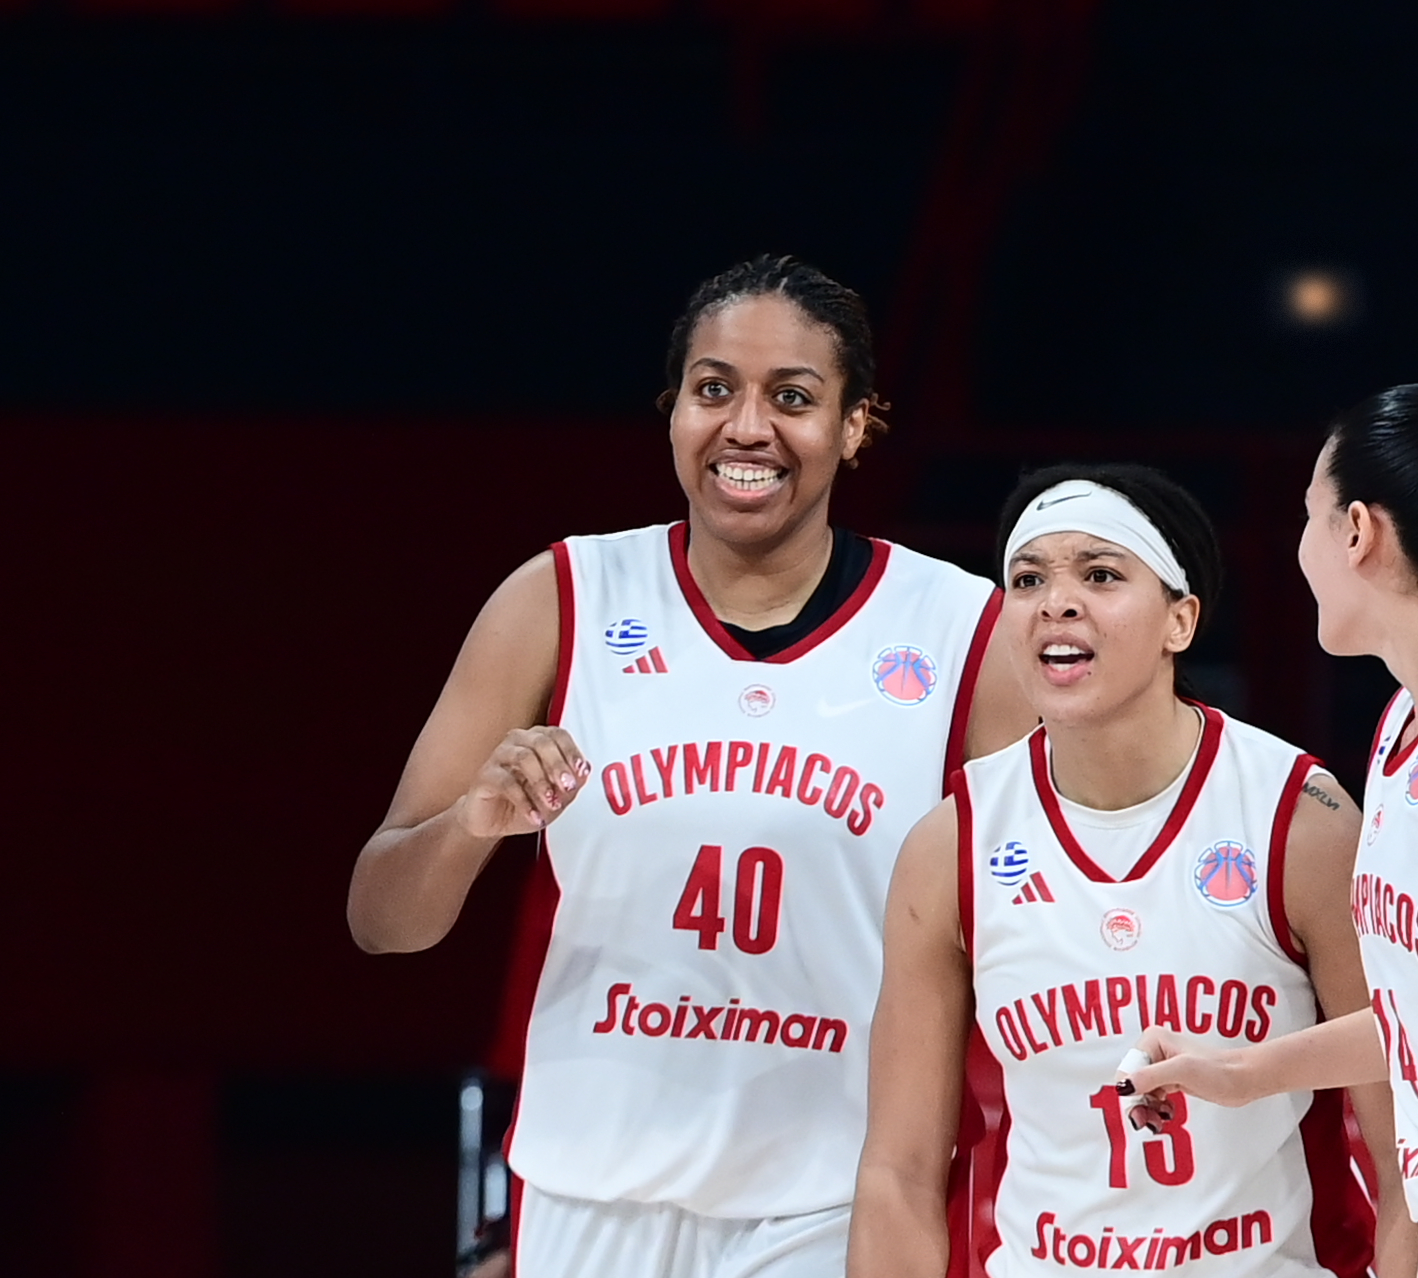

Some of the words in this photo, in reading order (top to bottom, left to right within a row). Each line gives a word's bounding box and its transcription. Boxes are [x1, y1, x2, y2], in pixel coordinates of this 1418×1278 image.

[602, 741, 884, 837] OLYMPIACOS
[673, 844, 784, 955] 40
[594, 983, 848, 1053] Stoiximan
[996, 974, 1276, 1061] OLYMPIACOS
[1090, 1085, 1195, 1189] 13
[1032, 1210, 1273, 1270] Stoiximan
